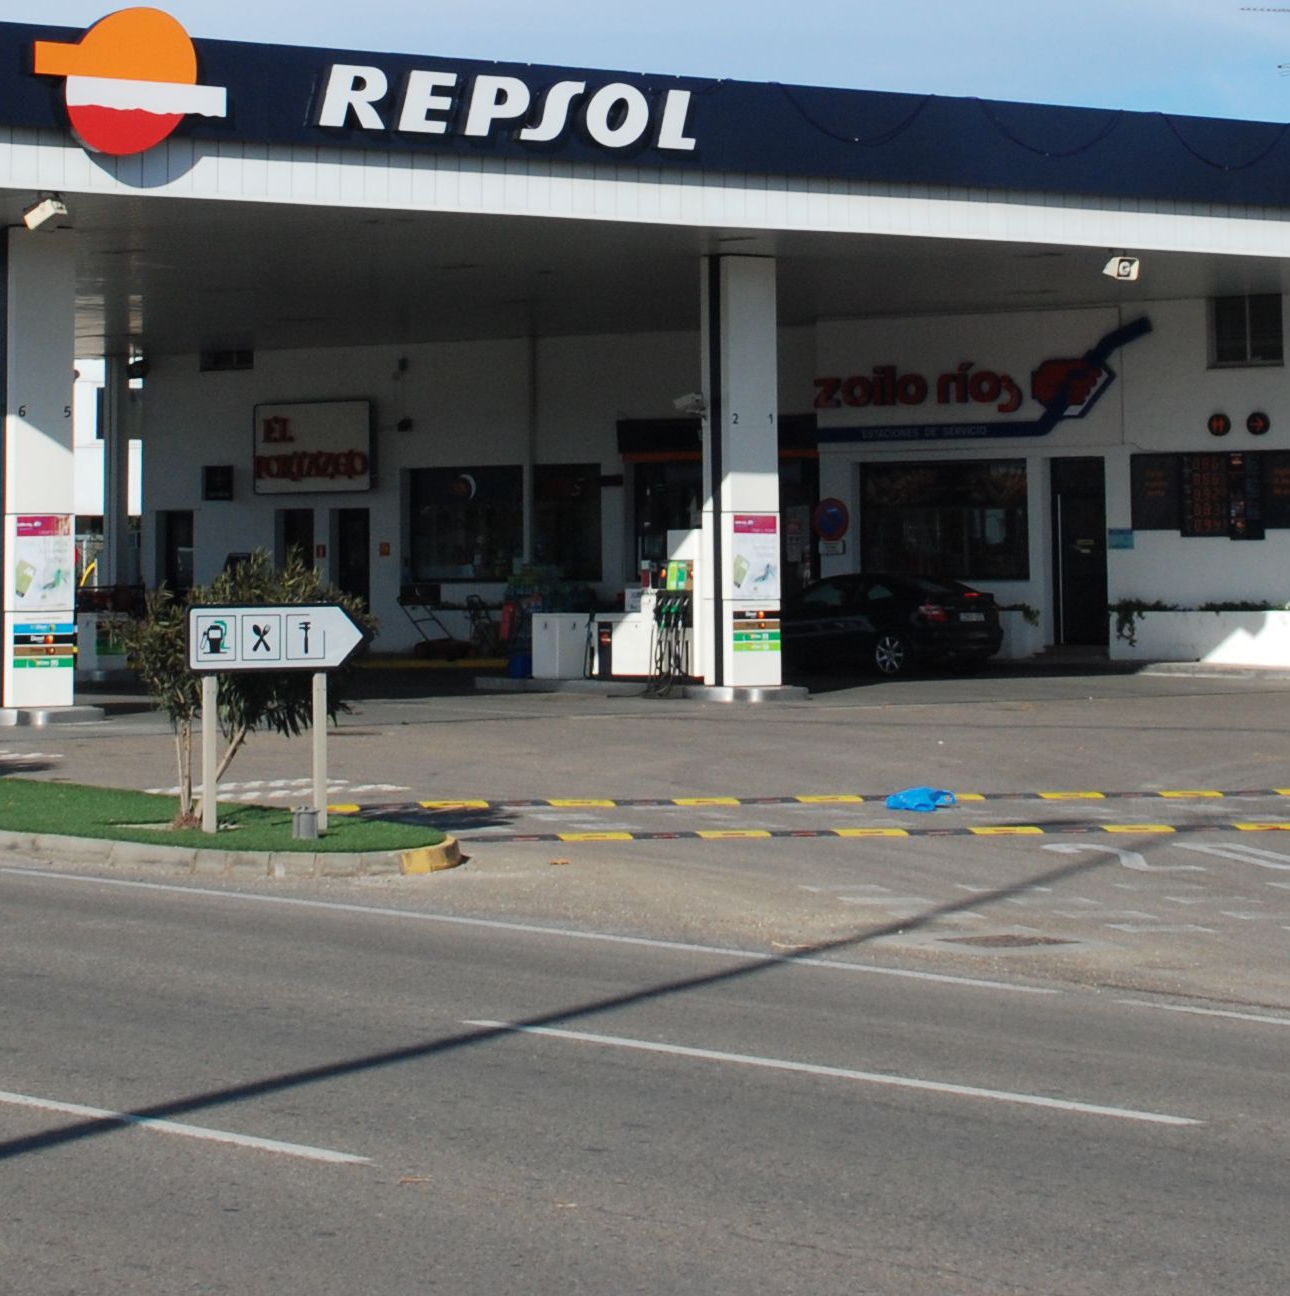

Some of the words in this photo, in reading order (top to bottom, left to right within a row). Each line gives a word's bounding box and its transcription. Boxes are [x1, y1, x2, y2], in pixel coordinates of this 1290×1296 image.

[319, 63, 696, 150] REPSOL
[813, 364, 928, 409] zoilo
[937, 361, 1023, 413] ríos
[18, 405, 26, 417] 6
[64, 405, 71, 418] 5
[732, 412, 739, 424] 2
[924, 427, 938, 436] DE
[943, 426, 988, 436] SERVICIO
